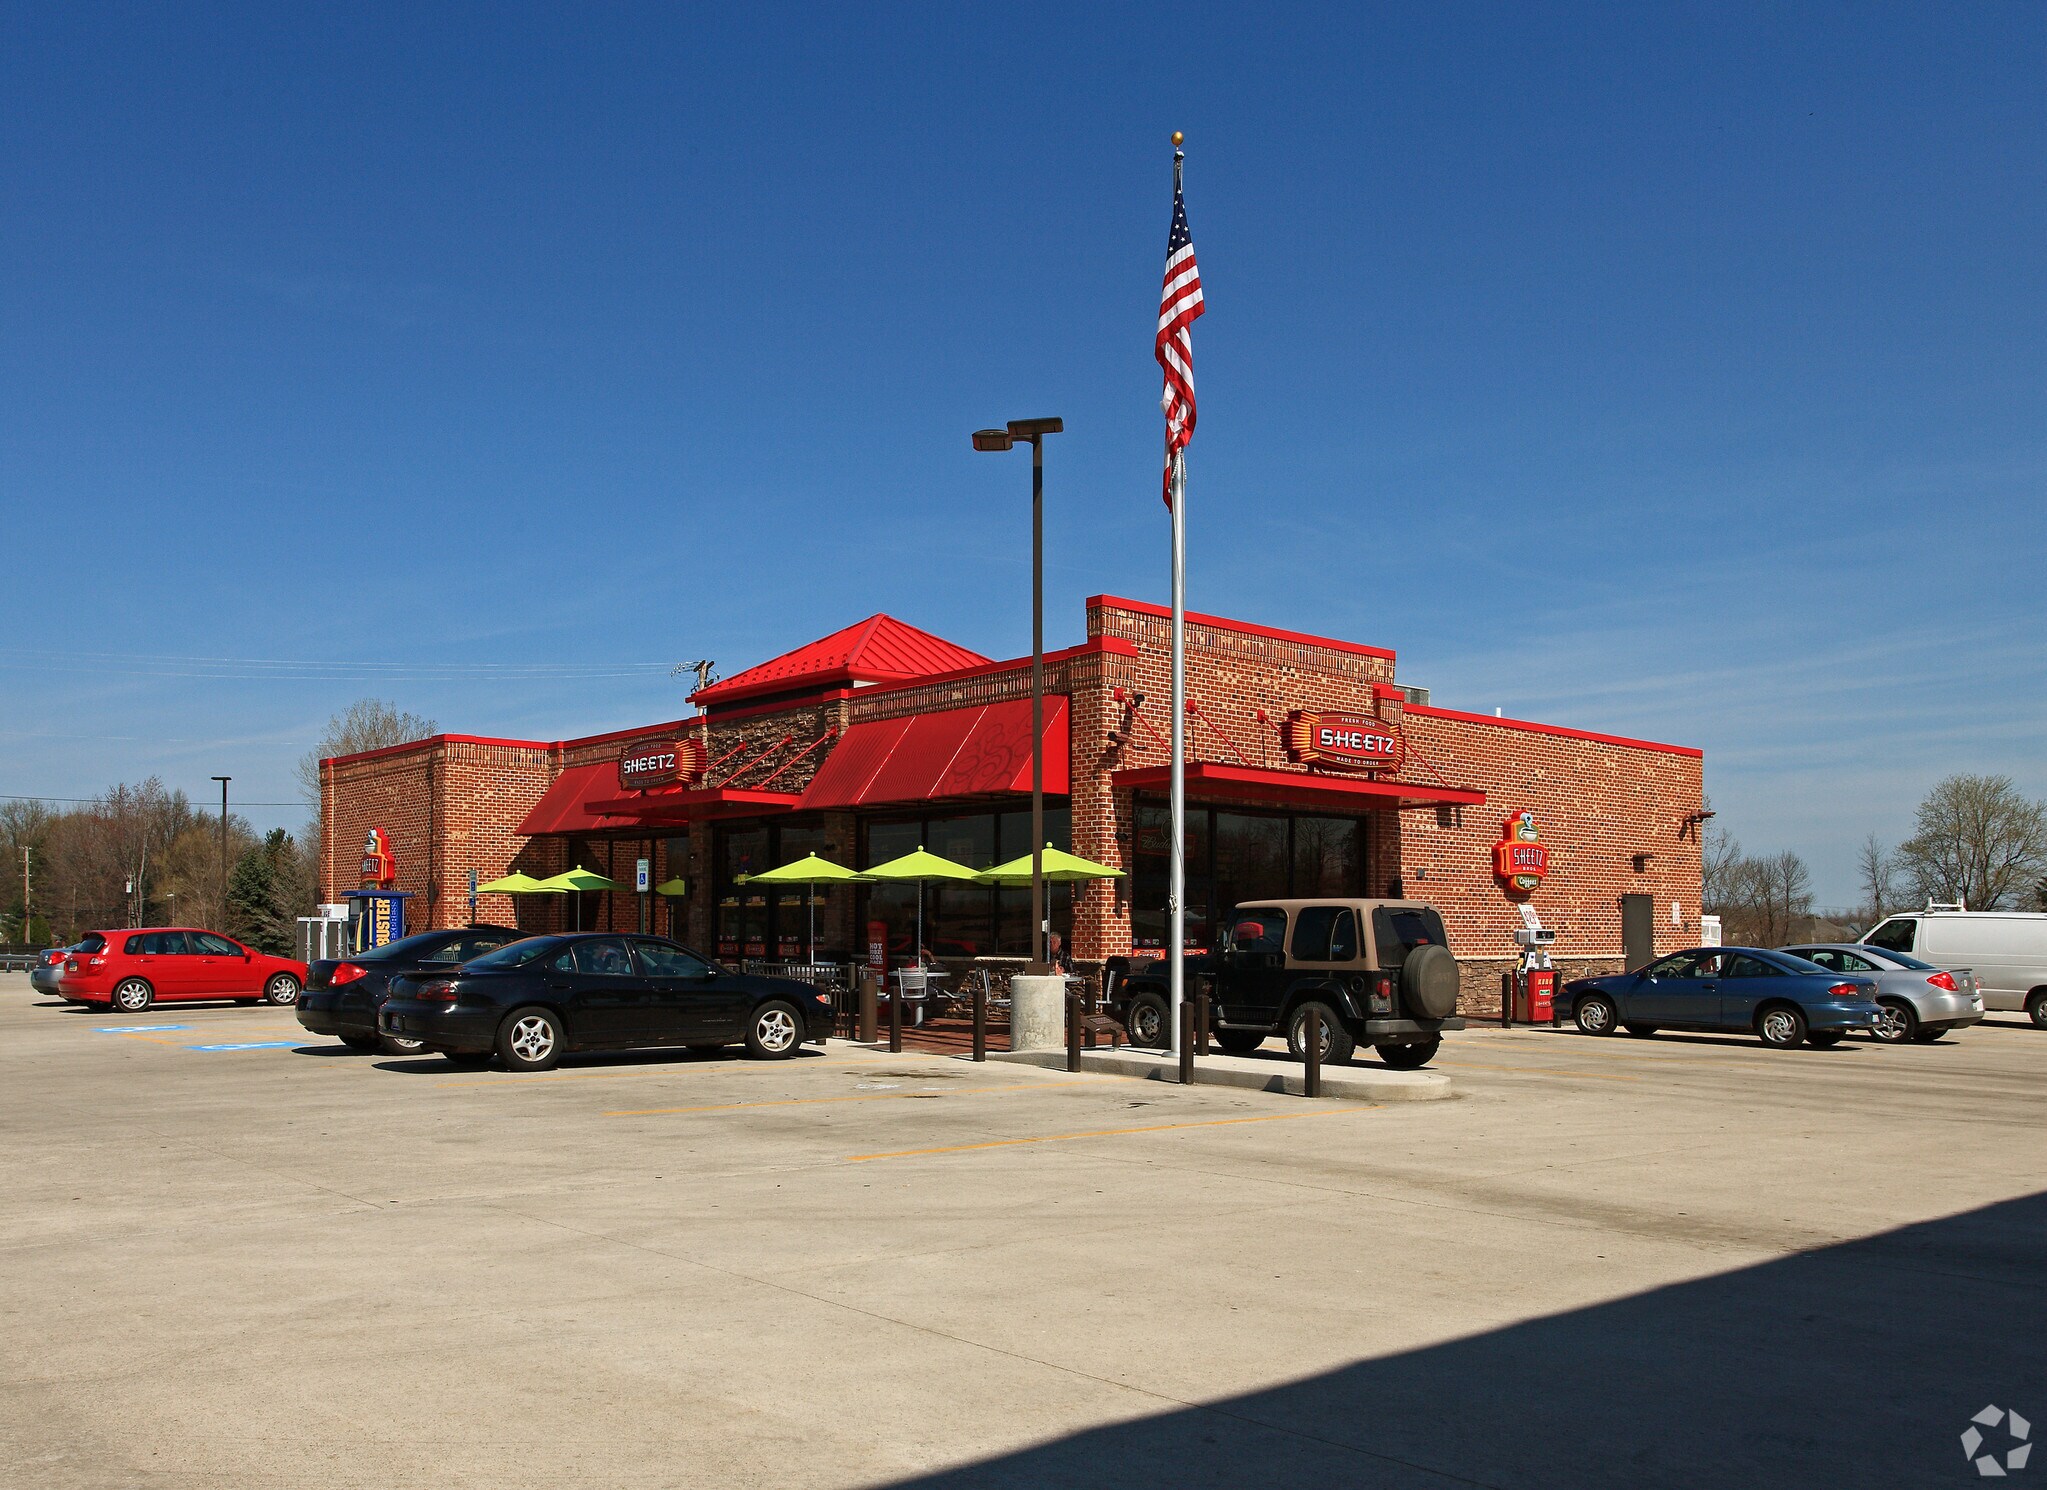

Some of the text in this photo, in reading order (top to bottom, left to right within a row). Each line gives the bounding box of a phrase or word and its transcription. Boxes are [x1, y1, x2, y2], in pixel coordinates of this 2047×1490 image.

[1320, 728, 1395, 754] SHEETZ
[623, 754, 675, 774] SHEETZ
[1336, 756, 1352, 764] MADE
[1513, 848, 1544, 867] SHEETZ
